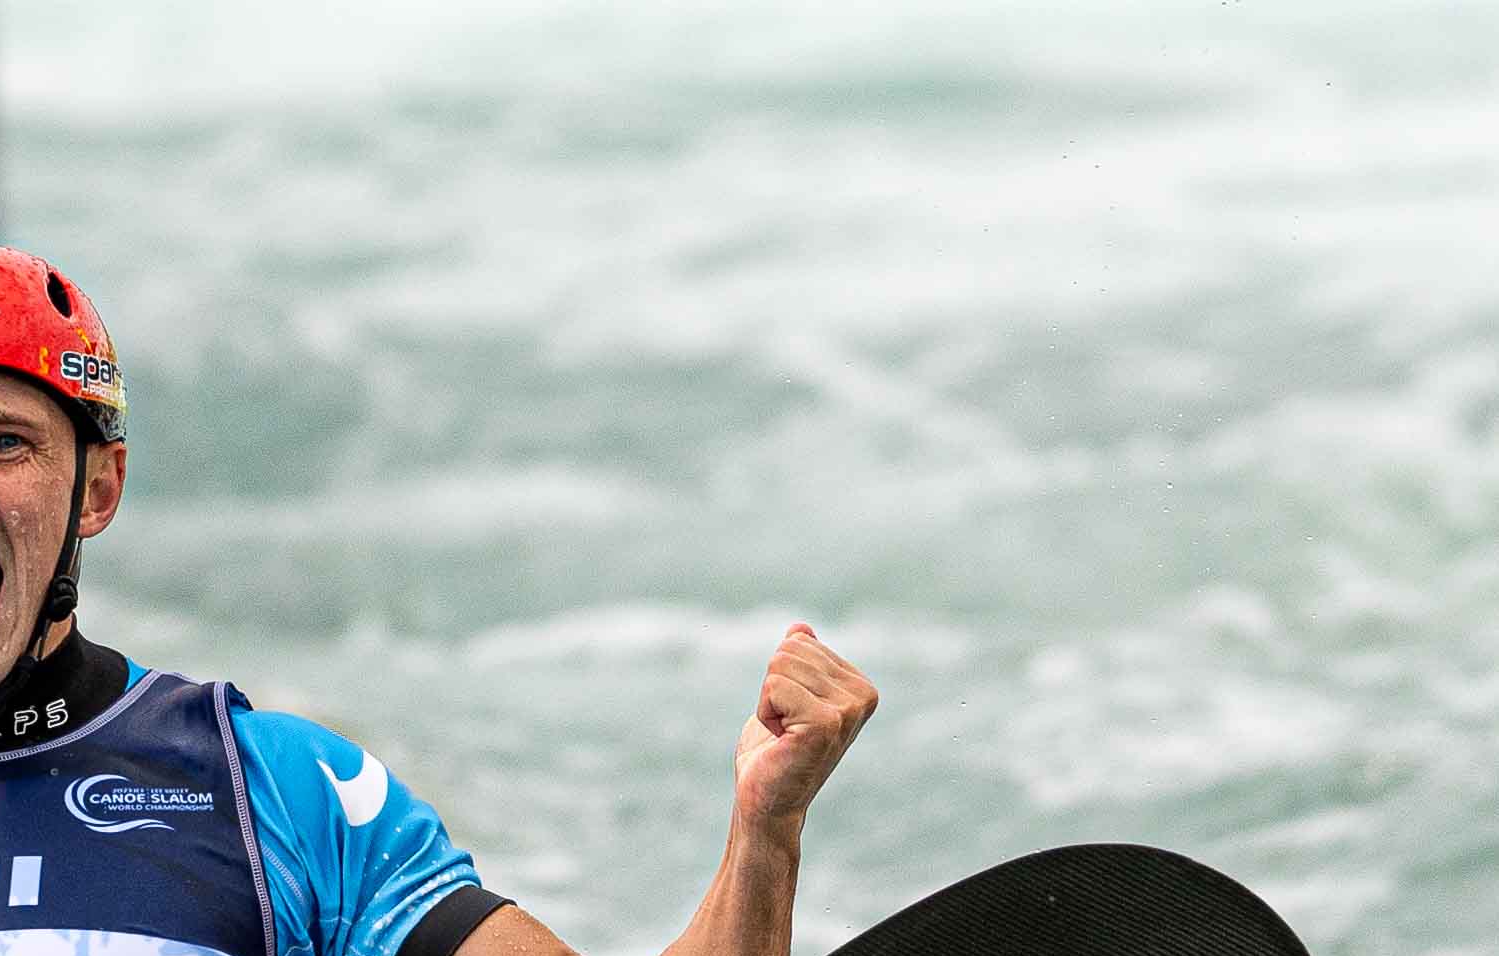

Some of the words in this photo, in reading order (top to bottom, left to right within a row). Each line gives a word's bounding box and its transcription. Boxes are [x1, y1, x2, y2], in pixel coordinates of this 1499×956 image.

[89, 793, 146, 804] CANOE
[150, 793, 213, 804] SLALOM
[107, 803, 143, 811] WORLD
[145, 803, 214, 811] CHAMPIONSHIPS
